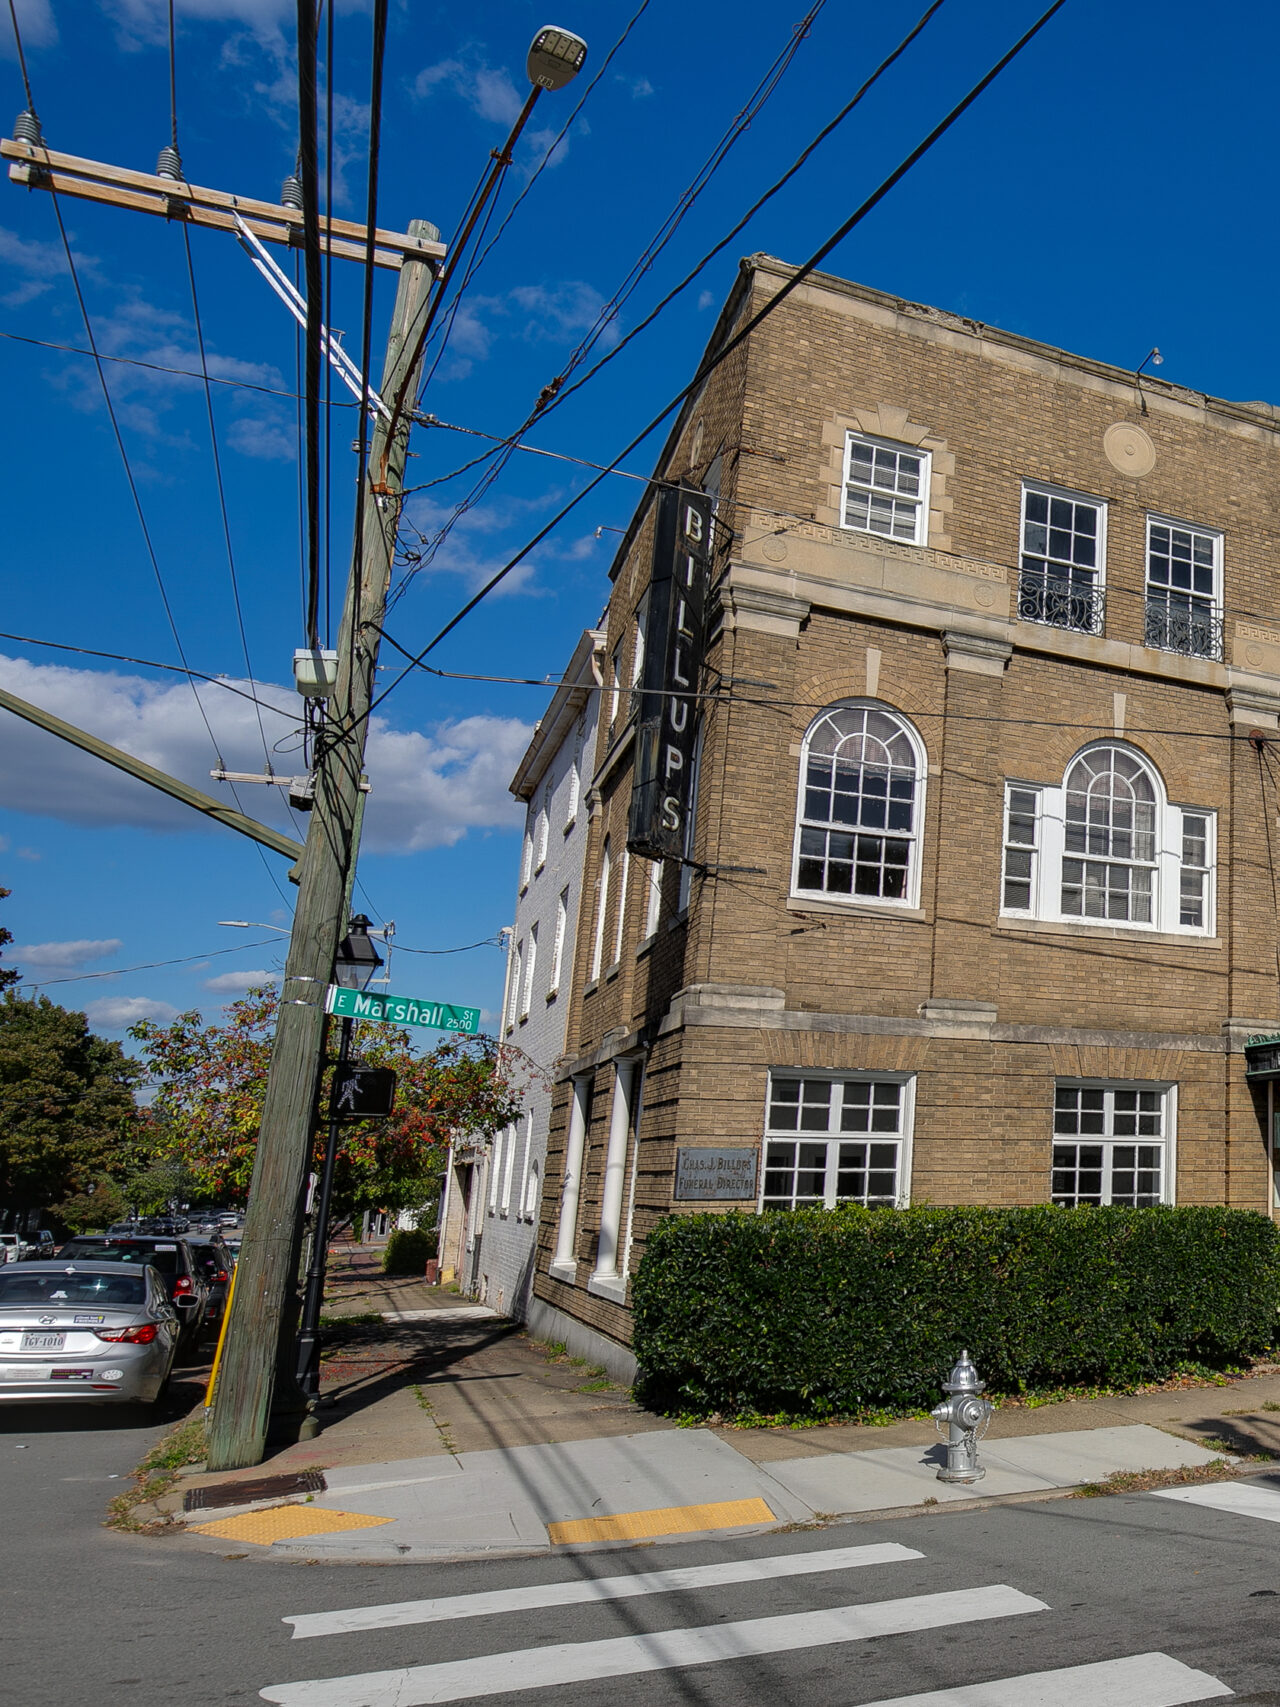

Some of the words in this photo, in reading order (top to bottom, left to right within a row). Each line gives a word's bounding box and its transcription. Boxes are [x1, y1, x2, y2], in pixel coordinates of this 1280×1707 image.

[661, 505, 702, 832] BILLUPS
[337, 995, 347, 1008] E
[353, 994, 443, 1026] Marshall
[463, 1010, 474, 1021] St
[446, 1017, 472, 1030] 2500
[678, 1177, 713, 1190] FUNERAL
[716, 1176, 754, 1190] DIRECTOR
